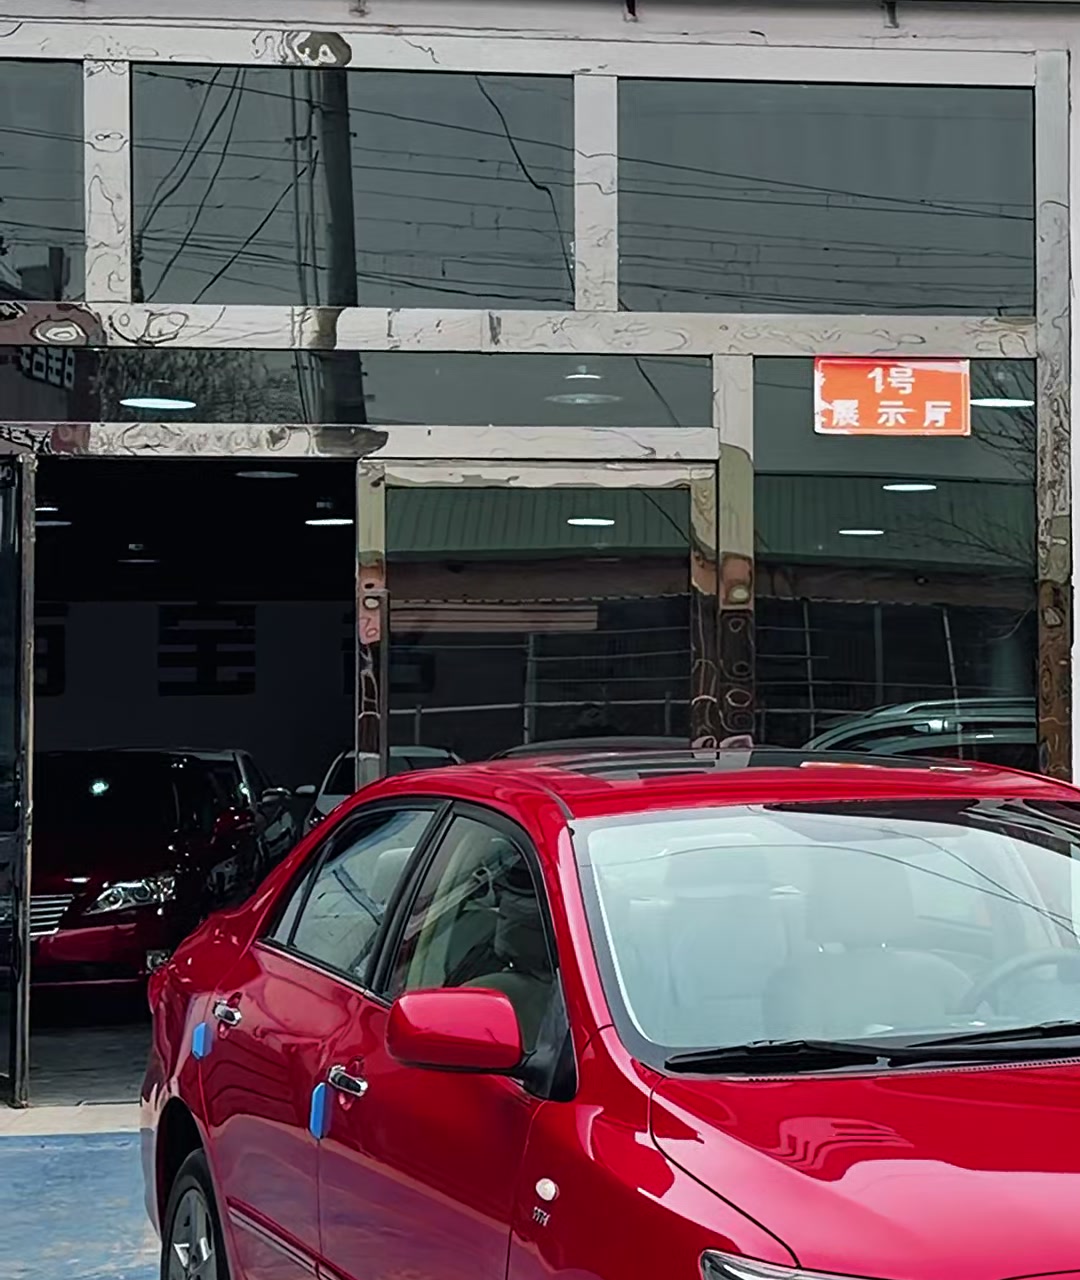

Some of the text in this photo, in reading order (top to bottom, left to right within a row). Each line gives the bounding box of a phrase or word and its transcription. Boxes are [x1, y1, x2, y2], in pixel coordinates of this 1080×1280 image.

[867, 367, 916, 395] 1号
[831, 399, 952, 427] 展示厅
